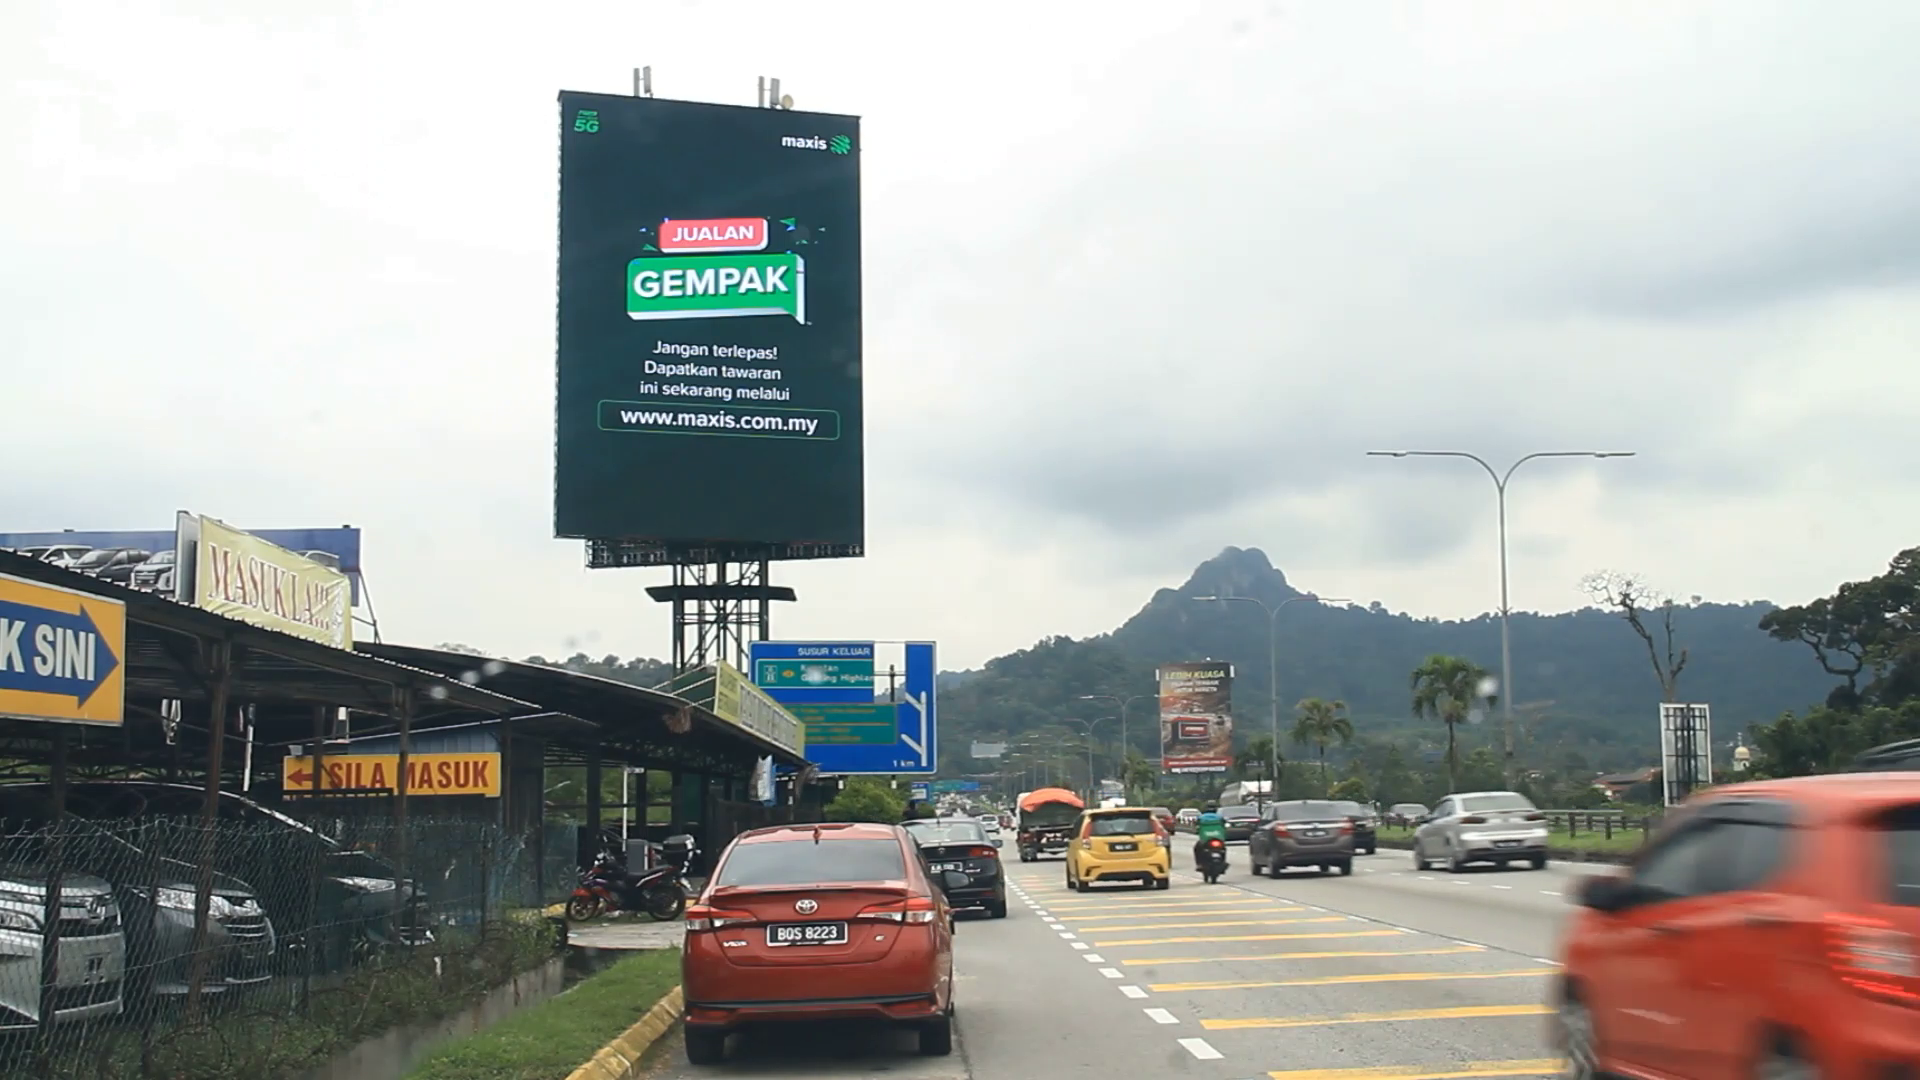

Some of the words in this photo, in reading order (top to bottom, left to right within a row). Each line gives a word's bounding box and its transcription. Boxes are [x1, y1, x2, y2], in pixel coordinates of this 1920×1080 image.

[574, 119, 599, 133] 5G
[782, 135, 828, 150] maxis
[672, 226, 754, 242] JUALAN
[633, 265, 789, 298] GEMPAK
[652, 341, 709, 358] Jangan
[712, 345, 778, 361] terlepas!
[644, 360, 718, 377] Dapatkan
[721, 365, 781, 380] tawaran
[640, 381, 659, 394] ini
[662, 383, 732, 401] sekarang
[736, 387, 790, 401] melalui
[620, 410, 818, 436] www.maxis.com.my
[207, 542, 289, 621] MASUK
[33, 623, 96, 681] SINI
[798, 647, 829, 656] SUSUR
[832, 647, 871, 656] KELUAR
[1193, 669, 1226, 679] KUASA
[892, 759, 898, 768] 1
[900, 759, 915, 768] km
[327, 761, 387, 789] SILA
[398, 760, 489, 788] MASUK
[805, 925, 837, 939] 8223
